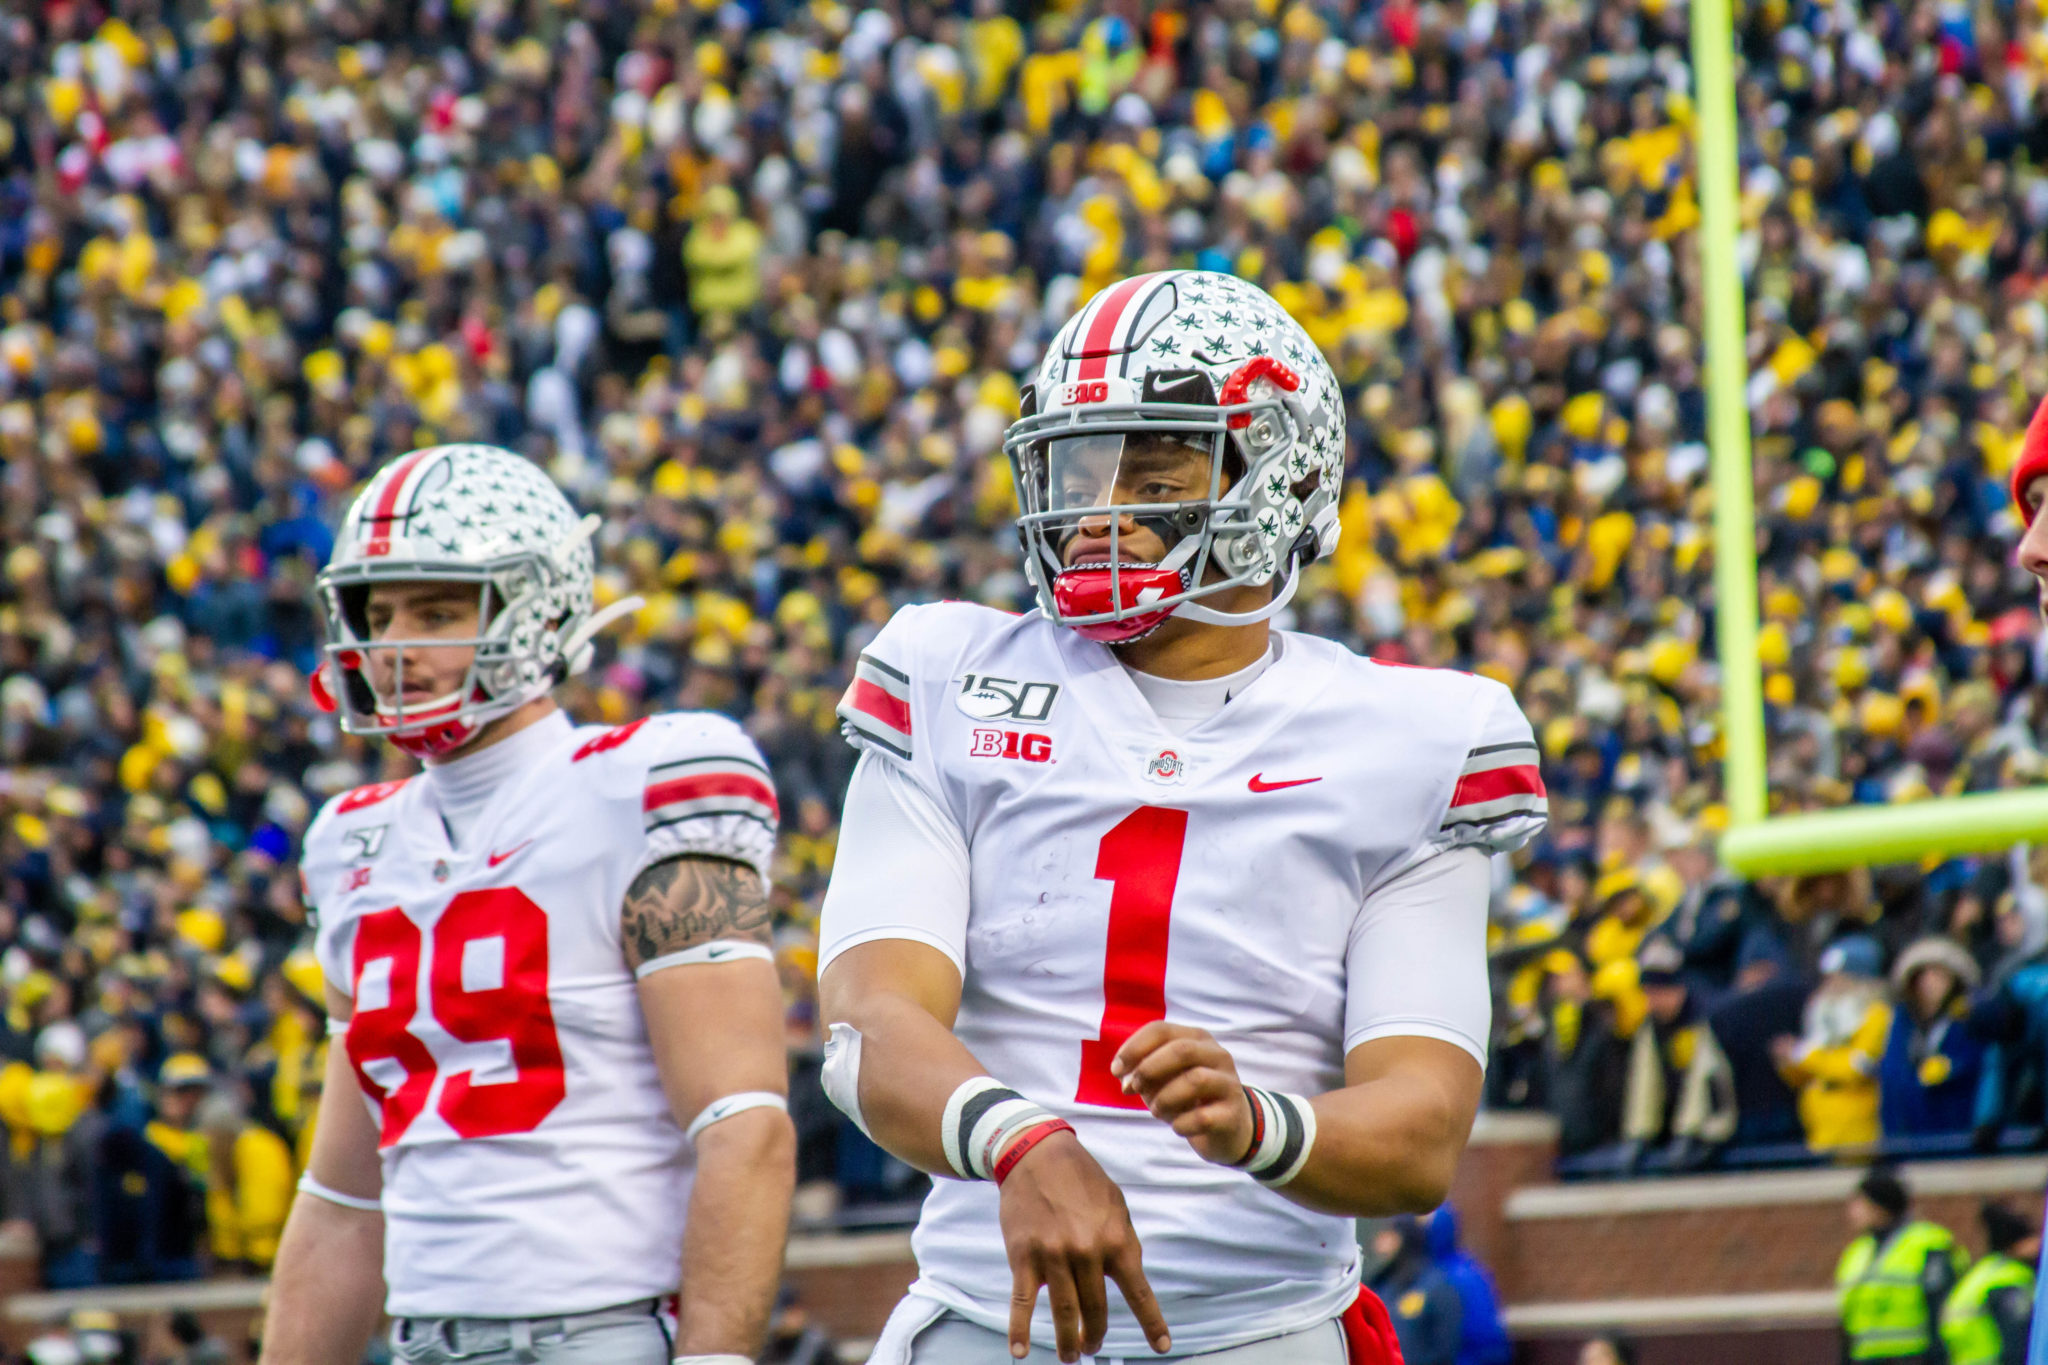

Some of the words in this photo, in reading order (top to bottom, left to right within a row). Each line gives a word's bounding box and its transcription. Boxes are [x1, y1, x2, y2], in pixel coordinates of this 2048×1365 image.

[960, 674, 1059, 720] 150
[346, 886, 567, 1150] 89
[1074, 805, 1189, 1110] 1
